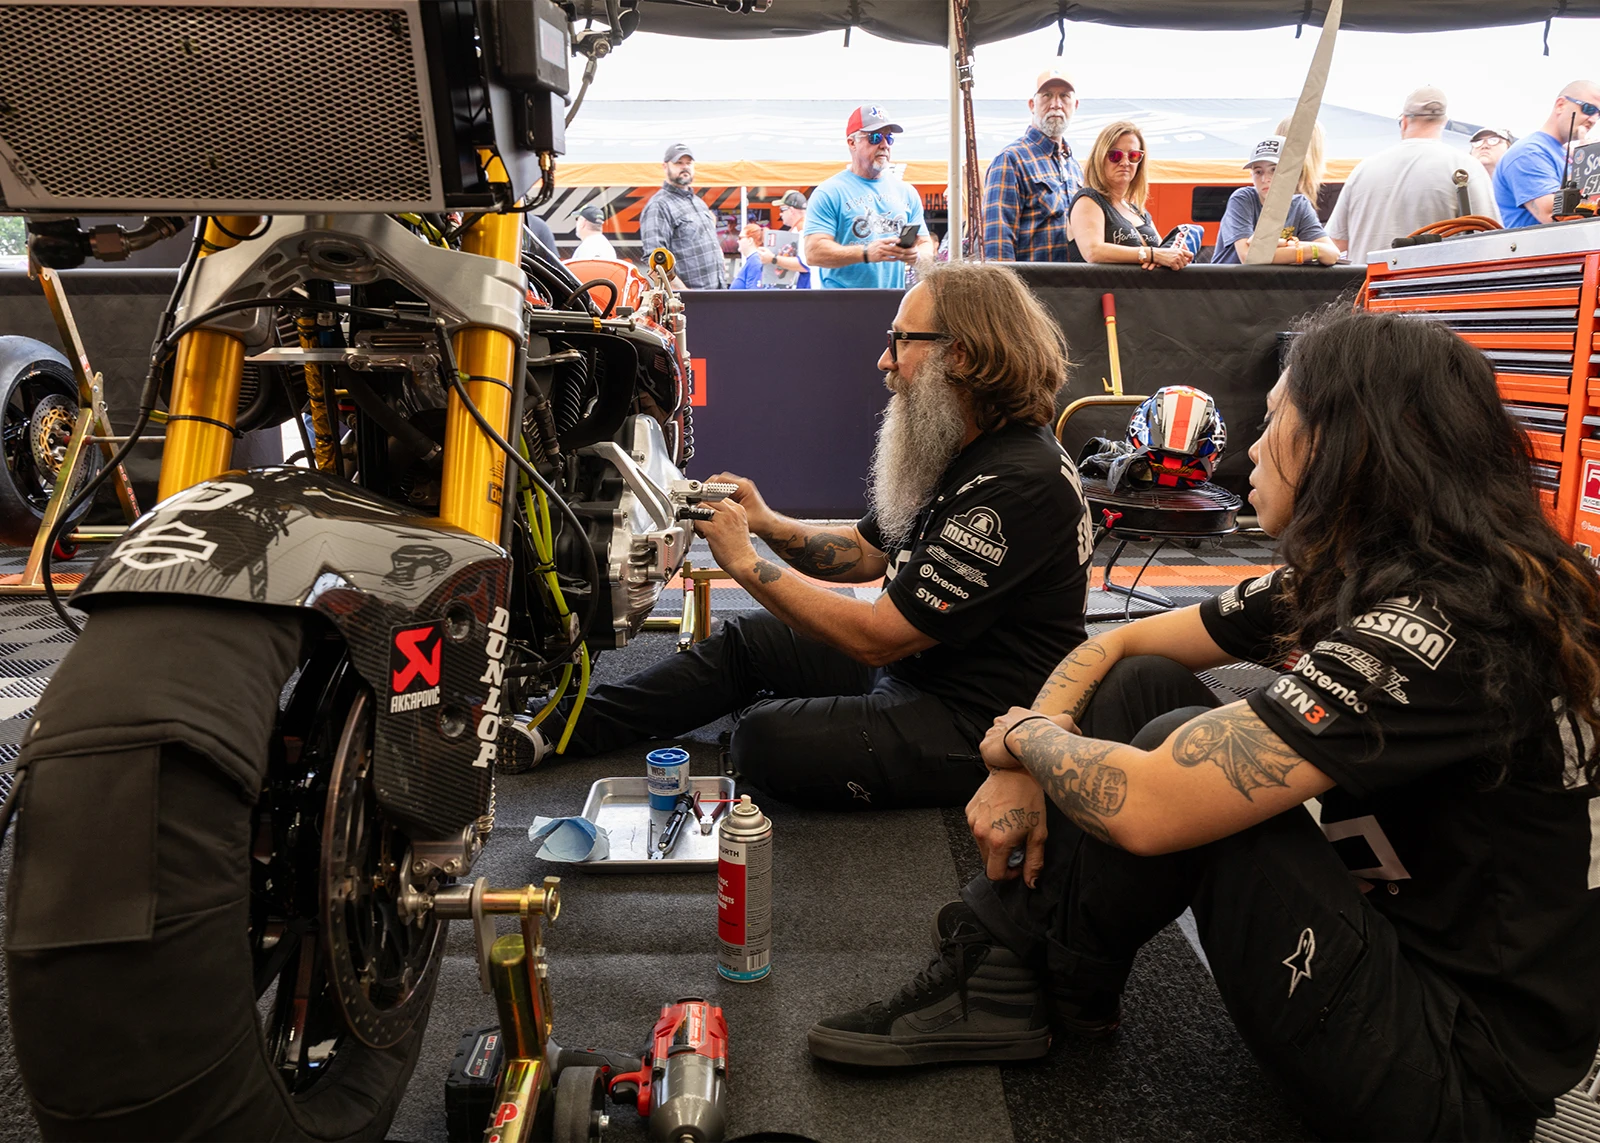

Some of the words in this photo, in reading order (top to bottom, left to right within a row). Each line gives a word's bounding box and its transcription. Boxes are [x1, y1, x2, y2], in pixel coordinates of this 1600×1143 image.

[916, 587, 950, 611] SYN3
[931, 571, 970, 600] brembo
[471, 606, 510, 768] DUNLOP
[1273, 678, 1327, 724] SYN3
[1303, 657, 1368, 714] brembo
